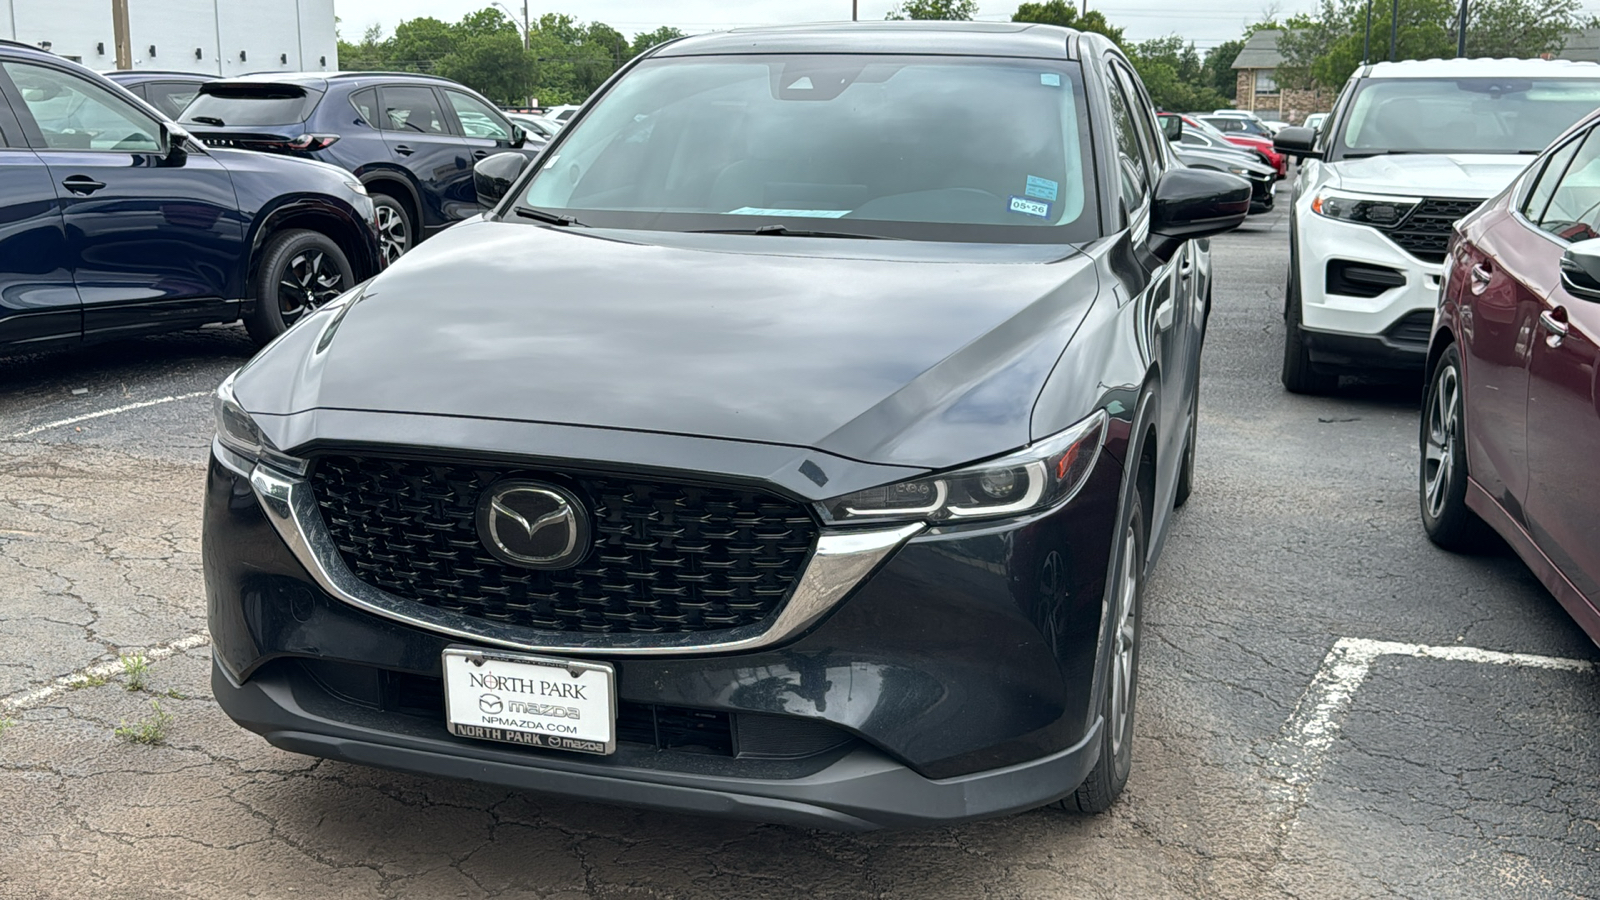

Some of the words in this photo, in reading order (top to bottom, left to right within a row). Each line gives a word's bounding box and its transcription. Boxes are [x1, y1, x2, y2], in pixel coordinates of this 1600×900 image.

[469, 673, 534, 694] NORTH
[540, 681, 587, 700] PARK
[508, 700, 580, 720] mazda
[457, 725, 500, 739] NORTH
[506, 731, 542, 745] PARK
[482, 716, 577, 734] NPMAZDA.COM
